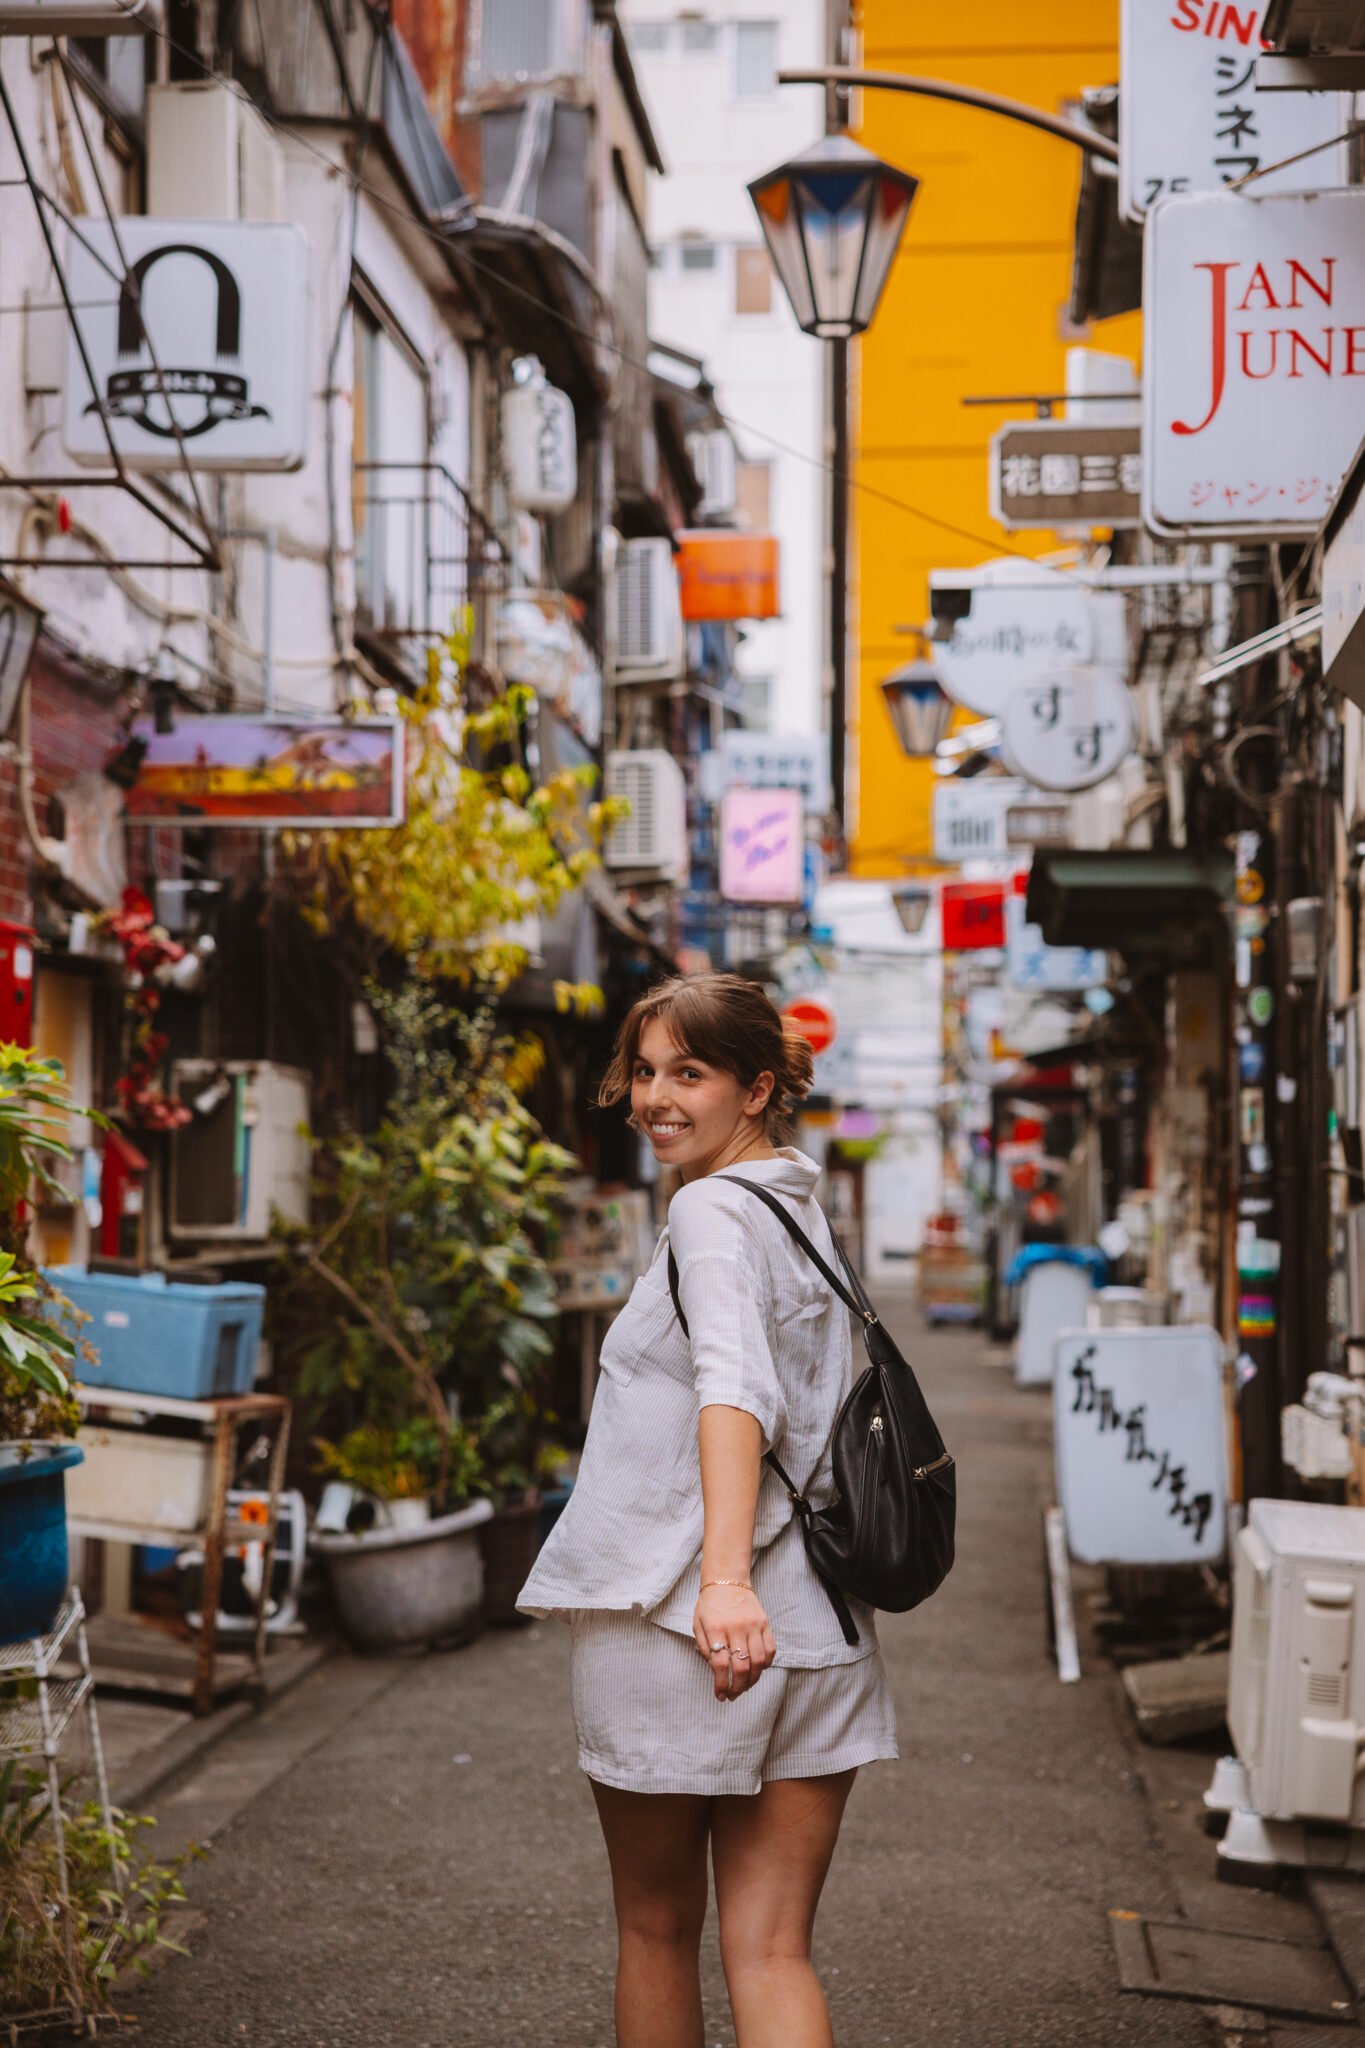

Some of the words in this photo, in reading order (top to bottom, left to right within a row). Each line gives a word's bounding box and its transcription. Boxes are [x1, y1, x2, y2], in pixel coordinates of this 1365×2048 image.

[1170, 0, 1275, 50] SIN
[1215, 56, 1259, 193] シネマ
